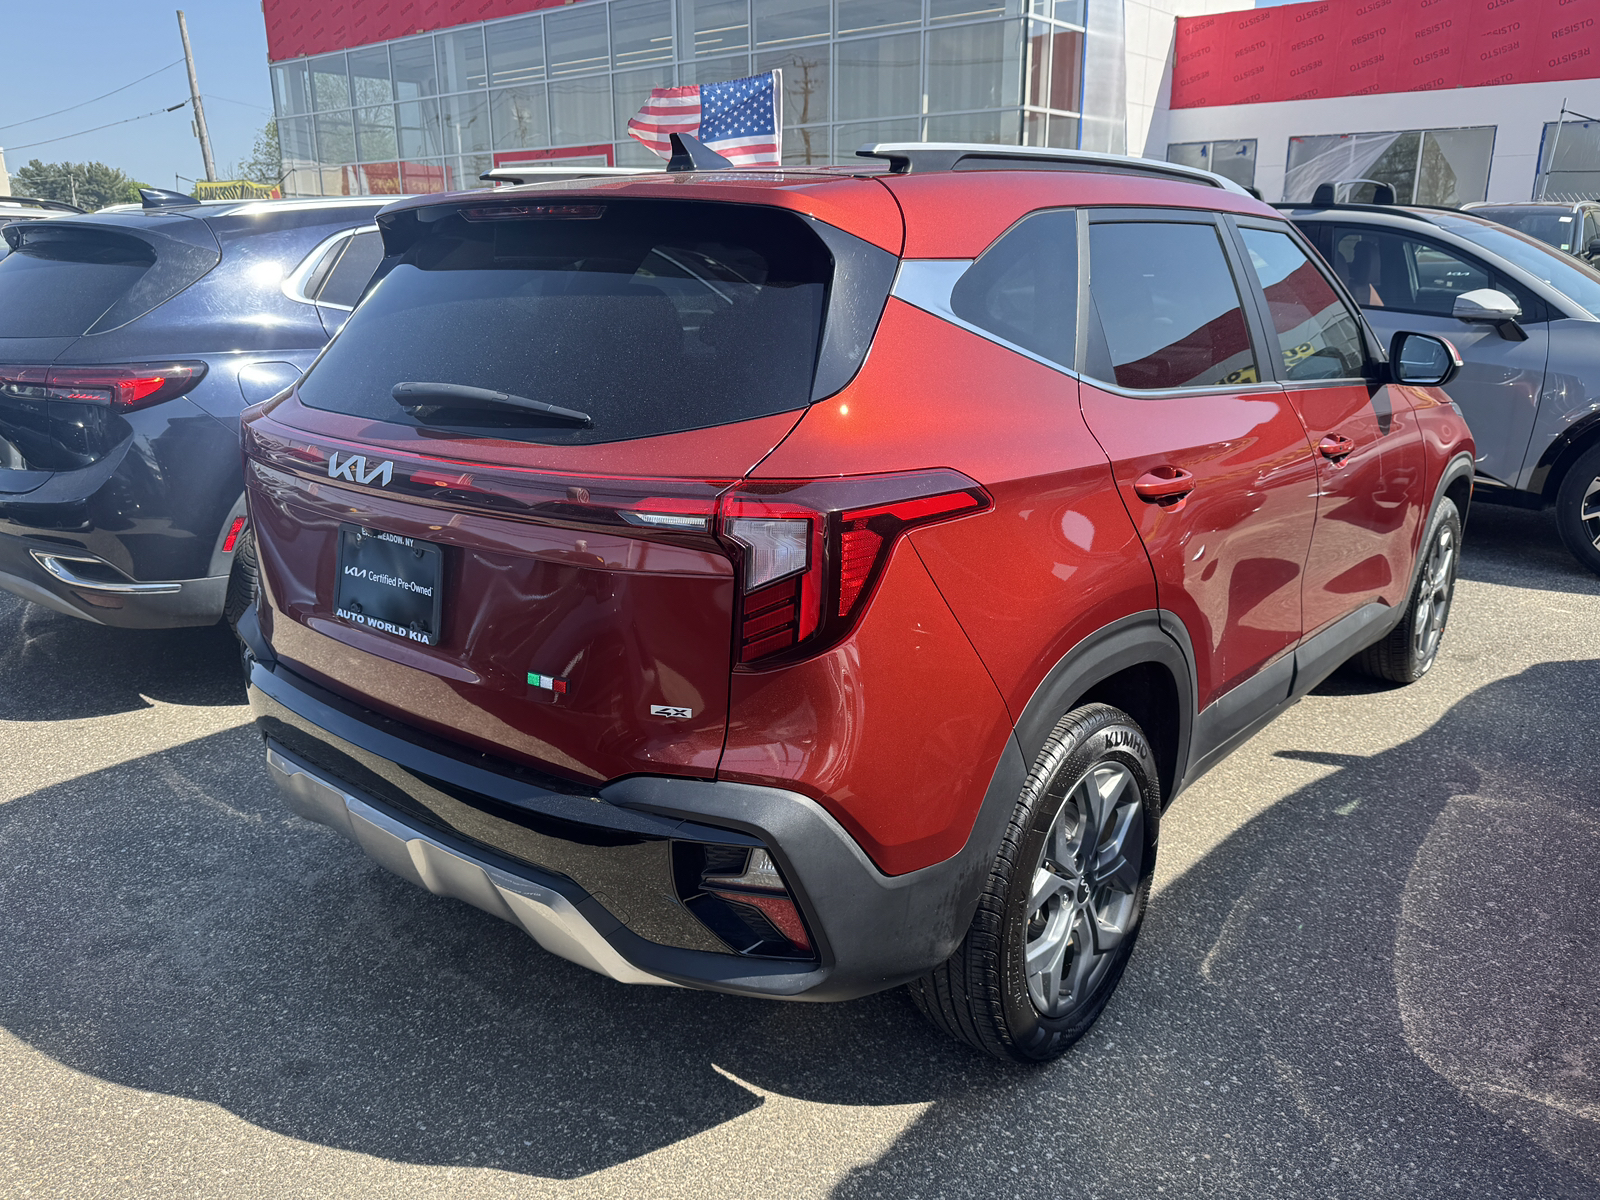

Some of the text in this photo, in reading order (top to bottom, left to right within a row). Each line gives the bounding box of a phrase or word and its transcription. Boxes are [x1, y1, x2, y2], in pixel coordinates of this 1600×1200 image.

[1239, 11, 1270, 30] RESISTO
[1296, 4, 1329, 22] RESISTO
[1185, 18, 1215, 36] RESISTO
[1351, 27, 1387, 46] RESISTO
[1414, 19, 1452, 39] RESISTO
[1481, 22, 1520, 36] SISTO
[1551, 18, 1594, 39] RESISTO
[1235, 40, 1266, 58] RESISTO
[1291, 33, 1325, 52] RESISTO
[1480, 41, 1520, 61] RESISTO
[1181, 46, 1211, 63] RESISTO
[1350, 53, 1385, 72] RESISTO
[1413, 46, 1450, 66] RESISTO
[1549, 47, 1590, 68] RESISTO
[1233, 65, 1264, 82] RESISTO
[1290, 59, 1323, 77] RESISTO
[1180, 70, 1209, 87] RESISTO
[328, 451, 393, 487] KIA
[405, 537, 414, 547] NY
[344, 565, 432, 597] KIA Certified Pre-Owned
[336, 608, 430, 645] AUTO WORLD KIA
[1105, 731, 1147, 759] KUMHO
